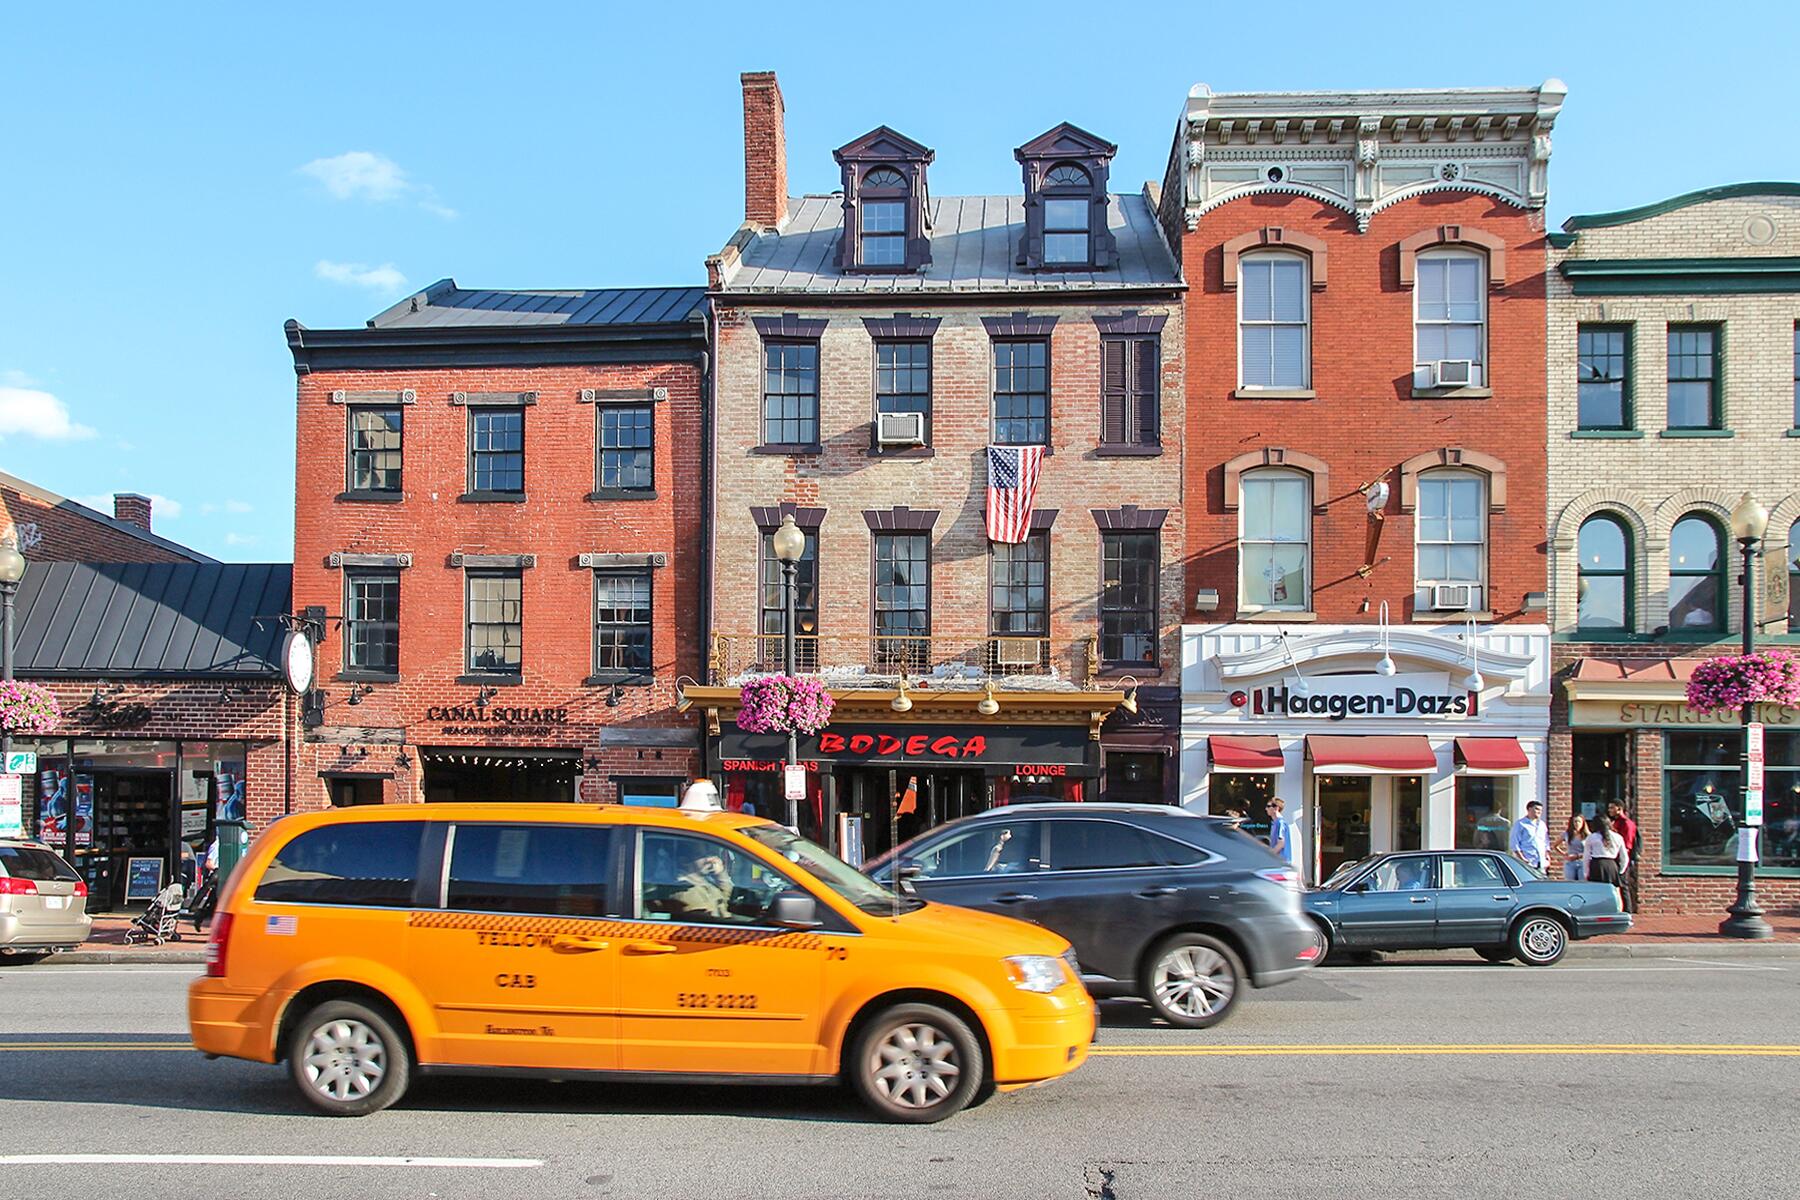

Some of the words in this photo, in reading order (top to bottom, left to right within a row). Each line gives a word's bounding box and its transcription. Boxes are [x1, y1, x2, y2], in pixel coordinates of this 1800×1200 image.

[1267, 687, 1466, 720] Haagen-Dazs
[427, 706, 490, 721] CANAL
[491, 707, 568, 724] SQUARE
[1620, 702, 1798, 724] STARBUKS
[819, 732, 987, 758] BODEGA
[723, 760, 776, 771] SPANISH
[779, 760, 818, 771] TAS
[1015, 765, 1066, 776] LOUNGE
[477, 932, 556, 948] YELLOW
[495, 973, 537, 988] CAB
[677, 993, 758, 1009] 522-2222
